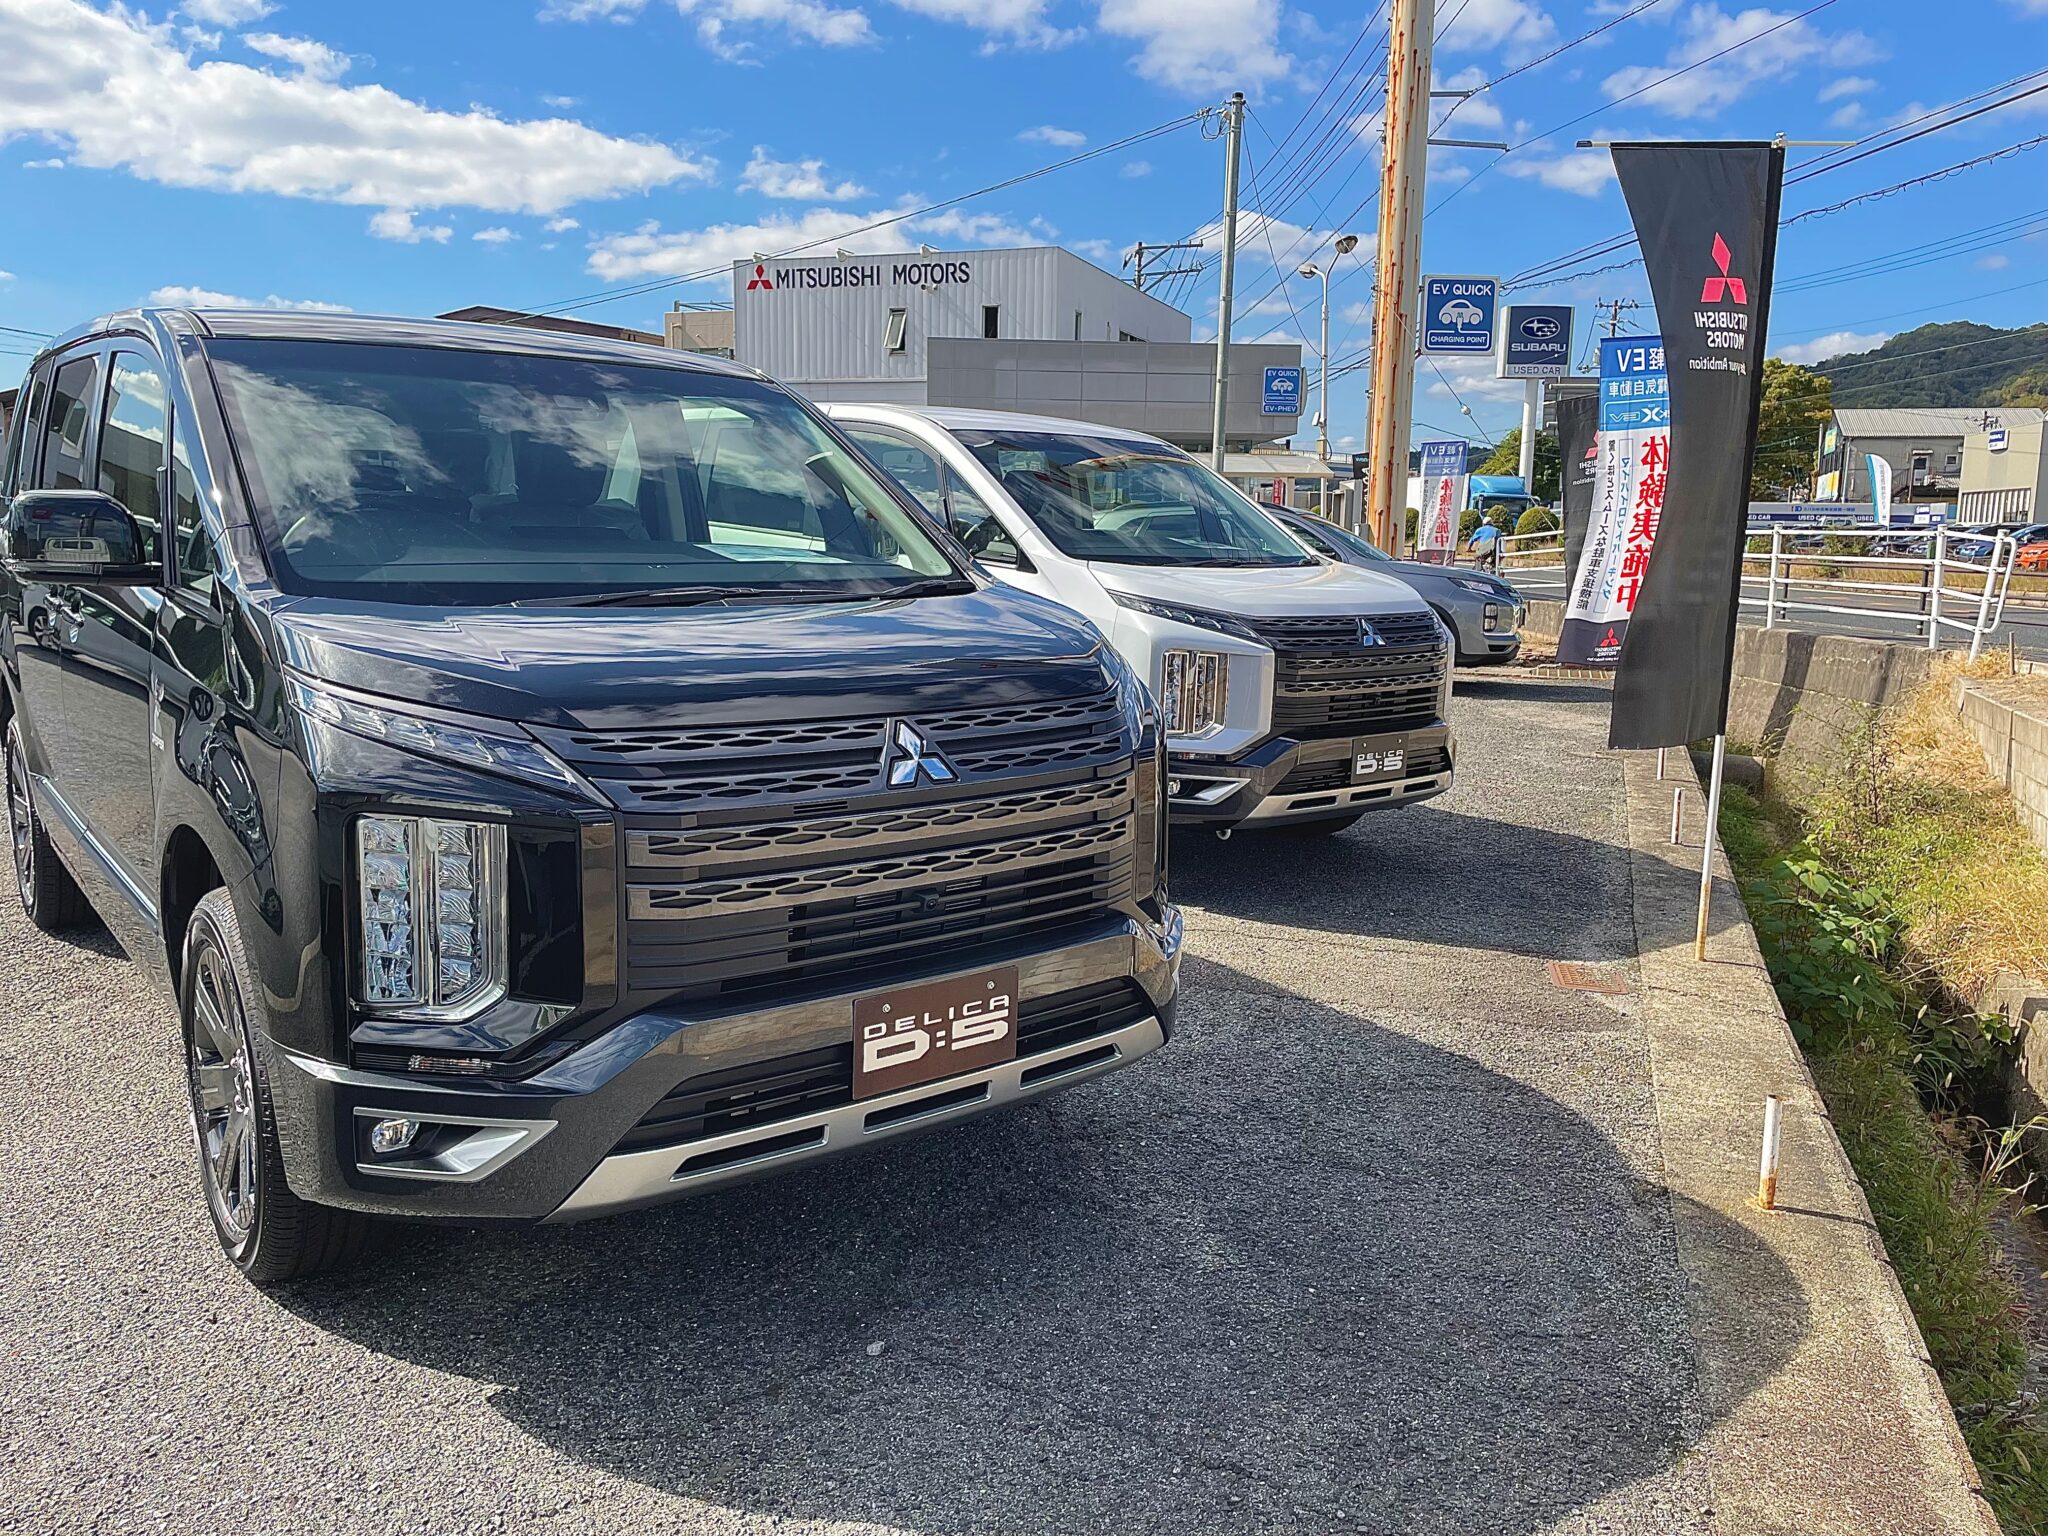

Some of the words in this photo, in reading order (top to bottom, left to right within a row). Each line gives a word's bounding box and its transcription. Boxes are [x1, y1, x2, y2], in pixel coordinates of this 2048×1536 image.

[776, 265, 881, 290] MITSUBISHI
[892, 261, 970, 286] MOTORS
[1432, 284, 1450, 295] EV
[1453, 284, 1492, 296] QUICK
[1430, 335, 1465, 343] CHARGING
[1511, 343, 1567, 352] SUBARU
[1513, 366, 1540, 375] USED
[1541, 366, 1561, 375] CAR
[1357, 749, 1404, 761] DELICA
[863, 994, 1010, 1039] DELICA
